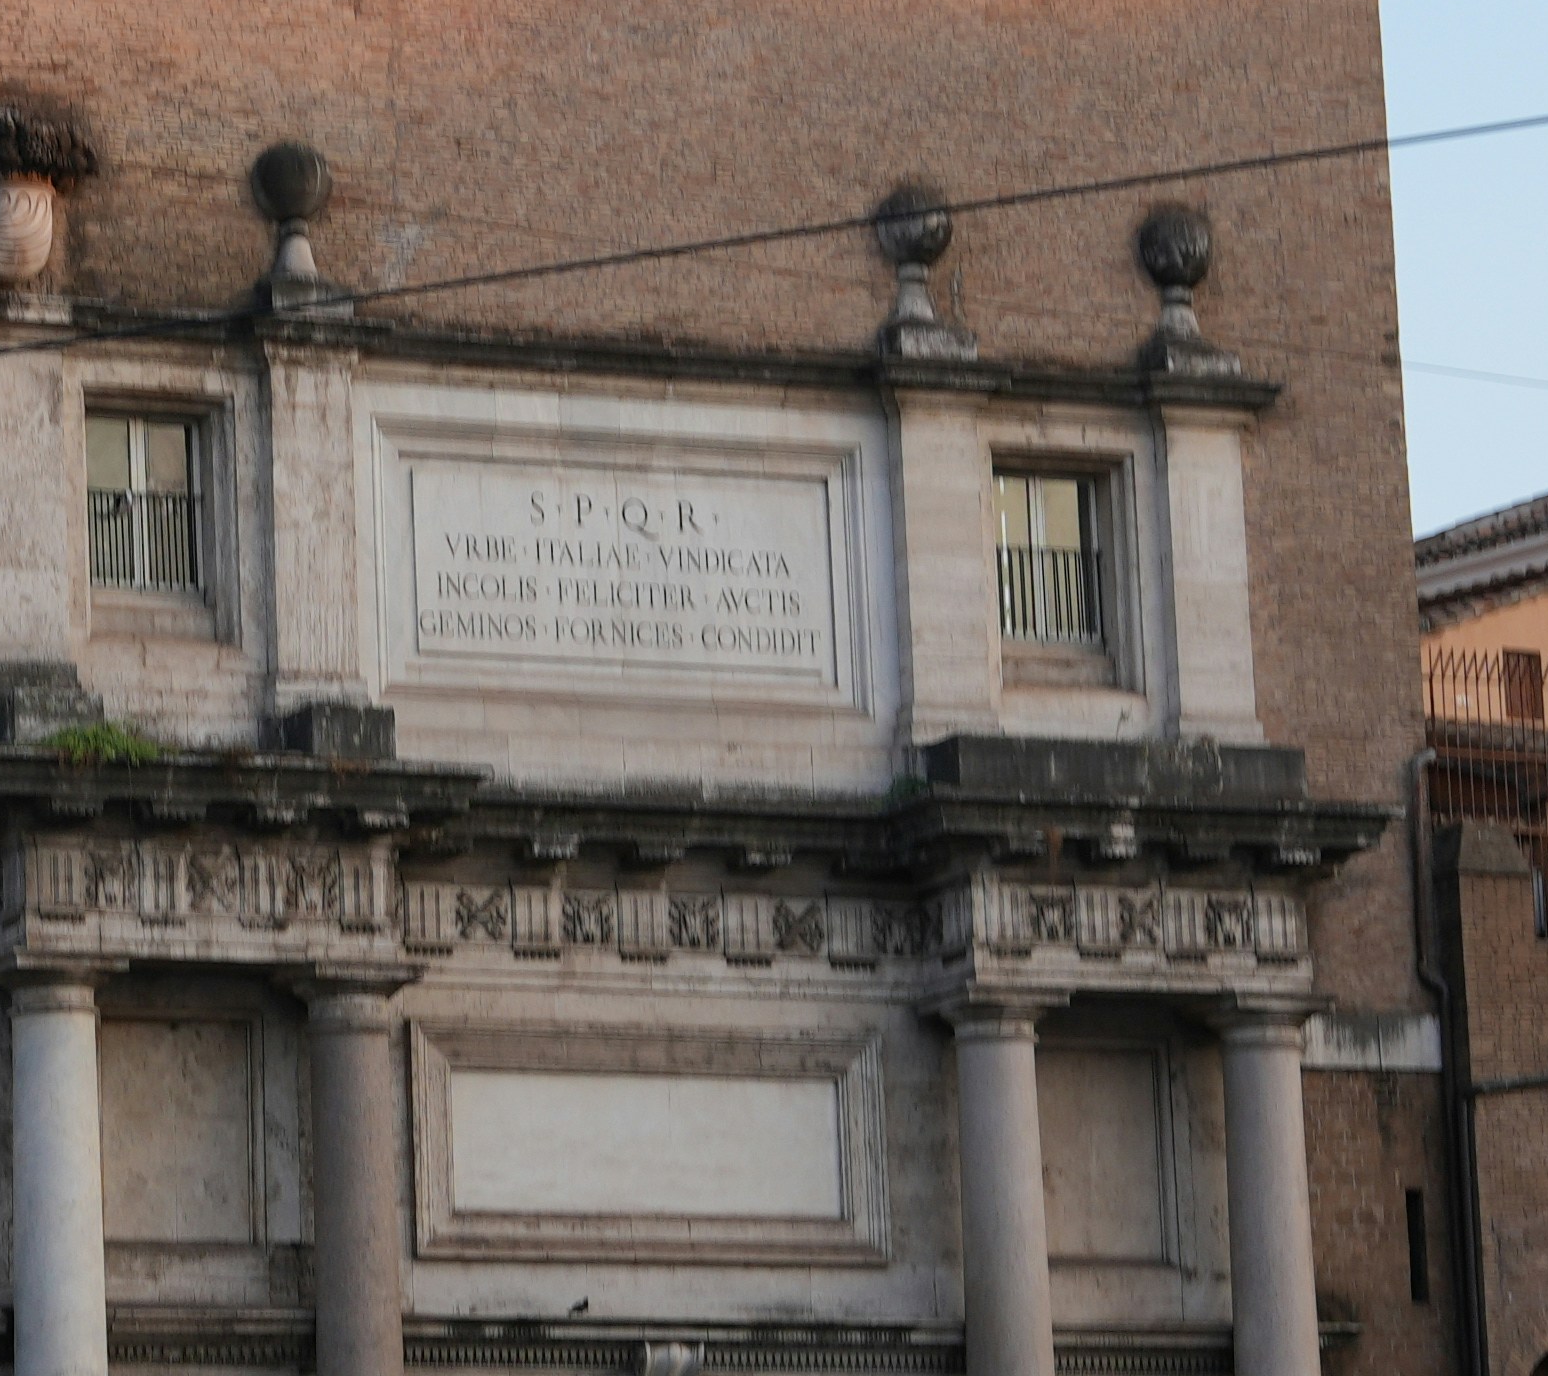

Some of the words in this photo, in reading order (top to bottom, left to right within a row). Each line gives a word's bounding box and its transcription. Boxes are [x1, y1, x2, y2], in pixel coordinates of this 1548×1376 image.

[445, 532, 518, 563] VRBE
[535, 538, 641, 571] ITALIAE
[658, 546, 792, 579] VINDICATA
[436, 571, 539, 603] INCOLIS
[557, 577, 695, 611] FELICITER
[715, 584, 801, 618] AVCTIS
[419, 609, 537, 643] GEMINOS
[555, 614, 684, 650] FORNICES
[701, 623, 822, 657] CONDIDIT
